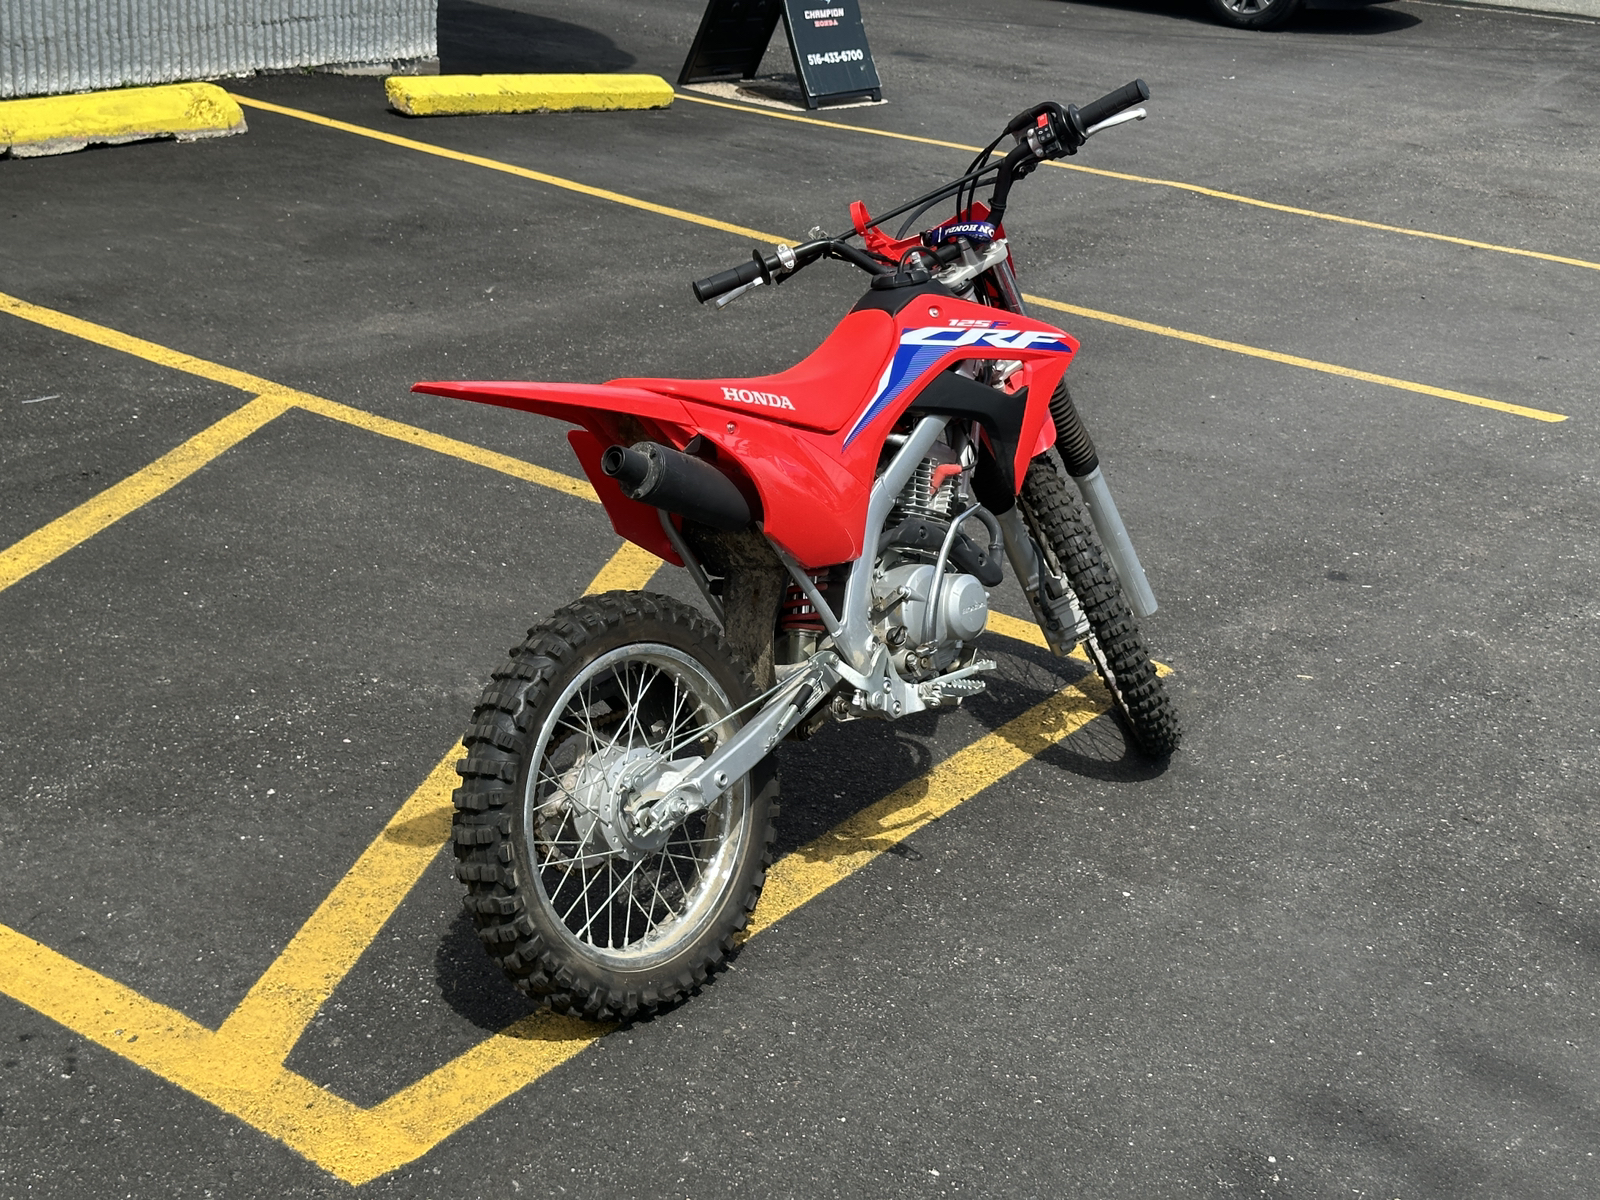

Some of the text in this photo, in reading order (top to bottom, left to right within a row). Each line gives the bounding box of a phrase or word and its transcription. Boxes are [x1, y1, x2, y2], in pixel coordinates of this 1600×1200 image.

[804, 8, 844, 19] CHAMPION
[807, 49, 864, 66] 516-433-6700
[948, 319, 1011, 329] 125F
[900, 327, 1067, 349] CRF
[720, 387, 796, 411] HONDA
